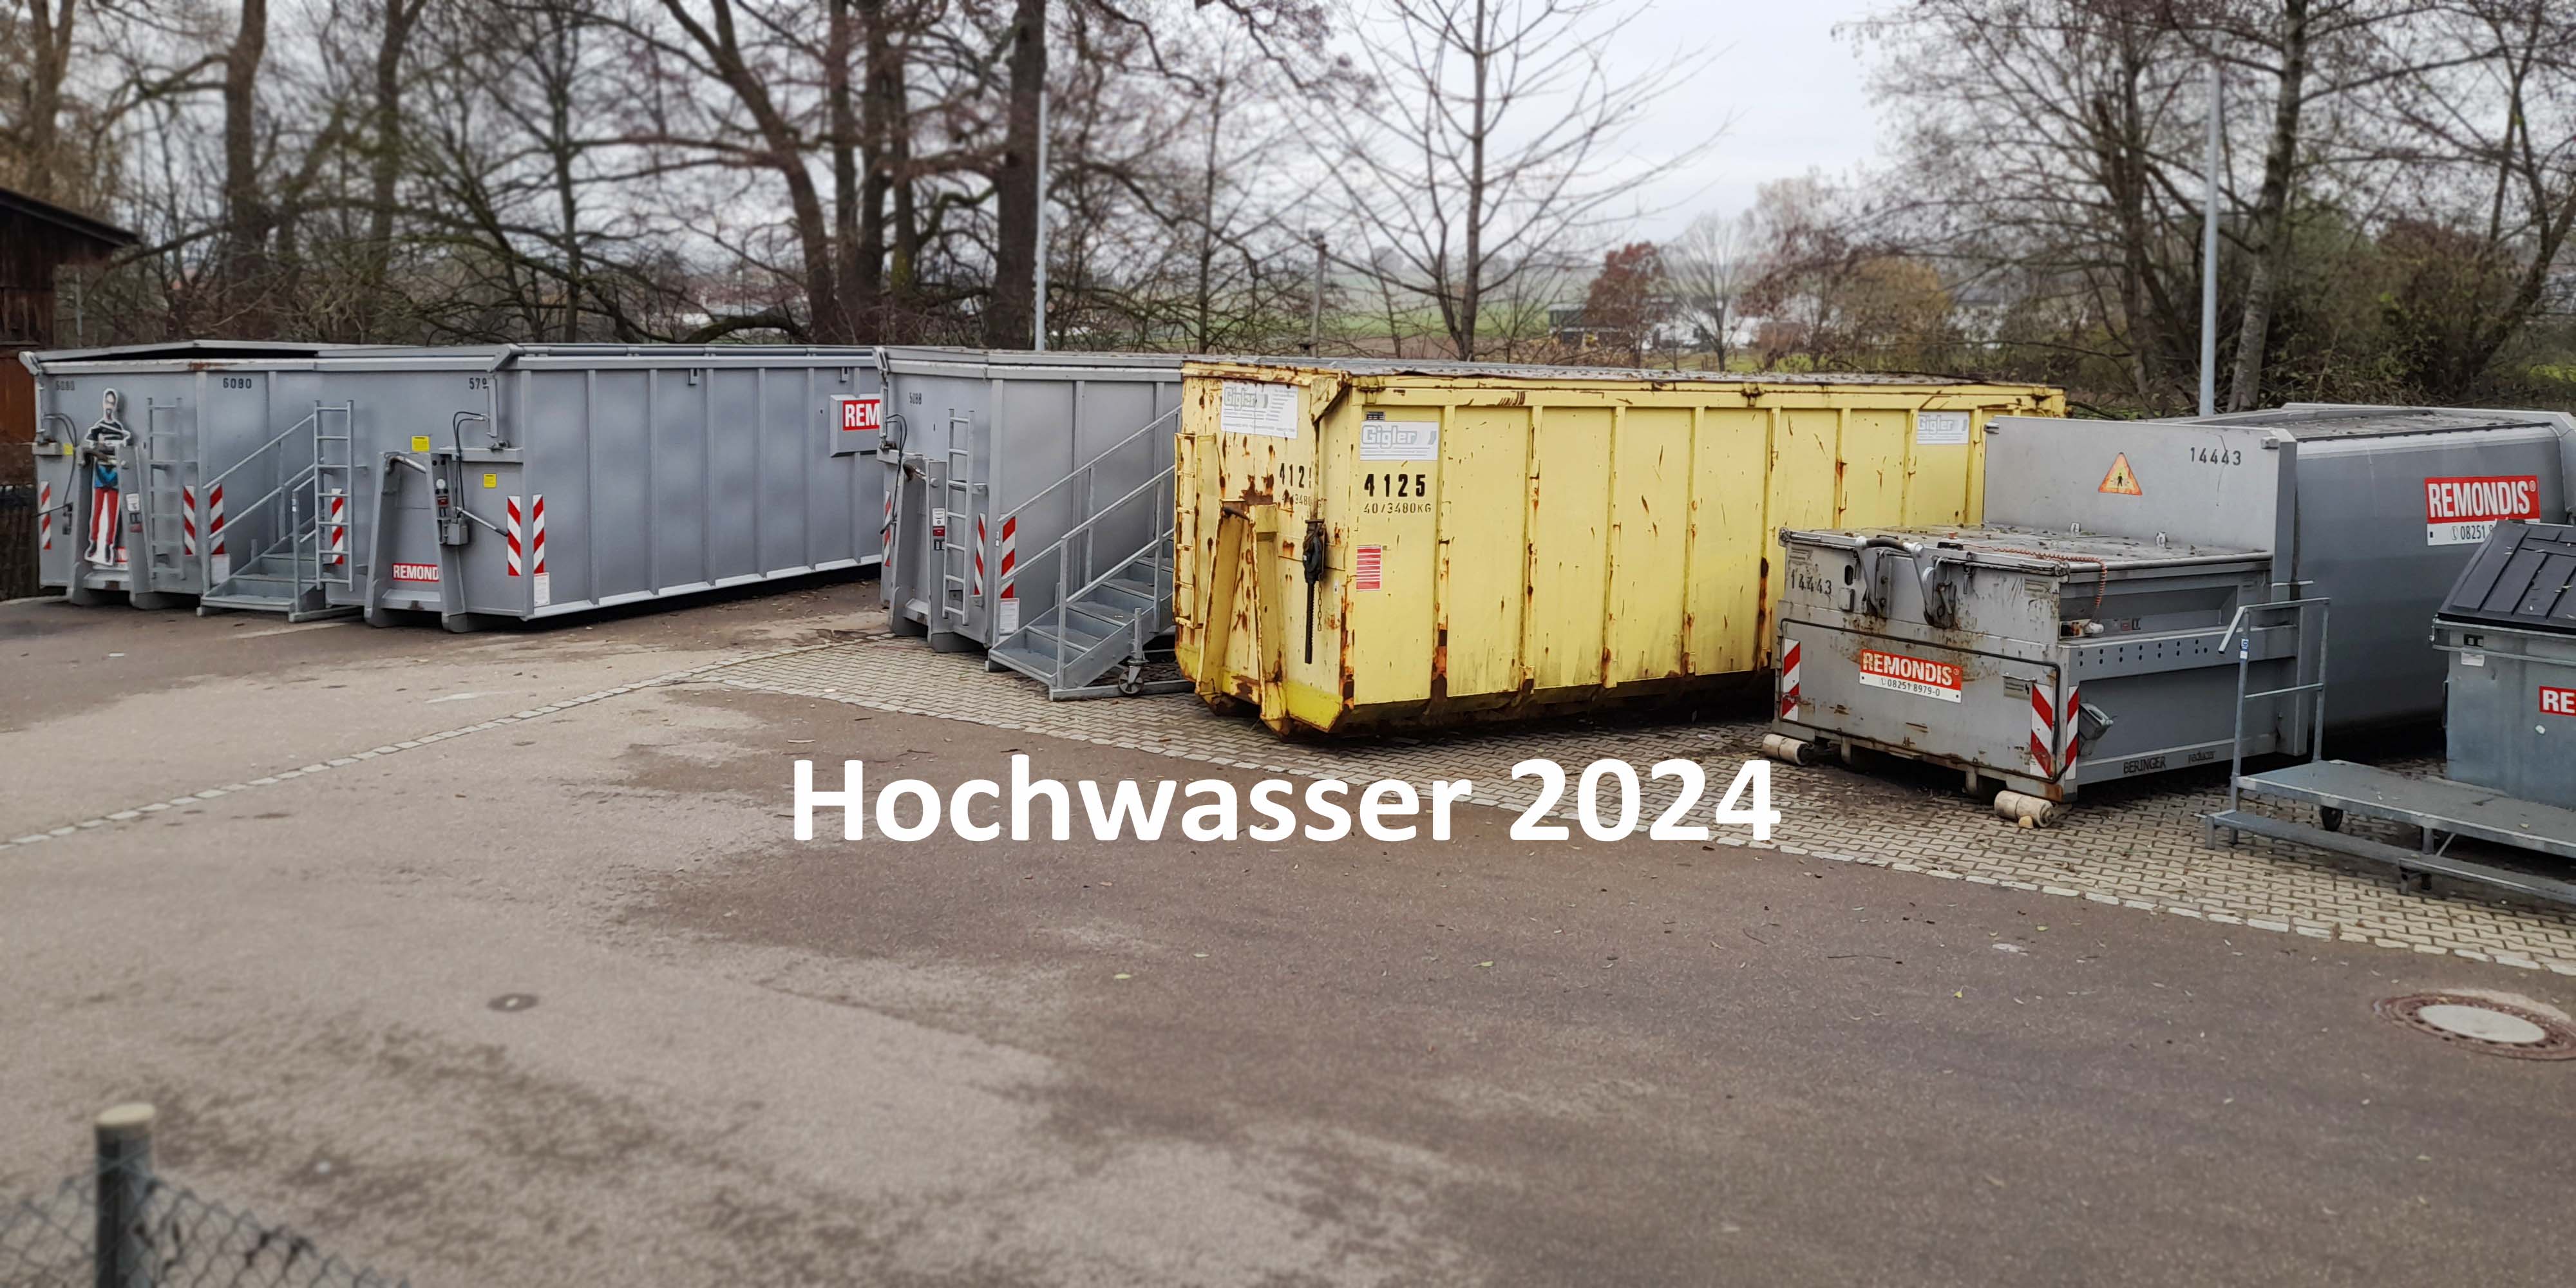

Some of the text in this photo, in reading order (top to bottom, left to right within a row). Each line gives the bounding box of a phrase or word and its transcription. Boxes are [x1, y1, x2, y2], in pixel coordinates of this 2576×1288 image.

[223, 377, 252, 389] 6080
[1224, 386, 1257, 411] Gigler
[845, 402, 880, 427] REM
[1918, 415, 1954, 435] Gigler
[1361, 424, 1417, 449] Gigler
[2190, 446, 2241, 466] 14443
[1363, 473, 1426, 497] 4125
[1363, 502, 1432, 515] 40/3480KG
[2460, 524, 2486, 540] 08251
[1887, 679, 1941, 697] 08251 8979-0
[2543, 689, 2576, 714] RE
[2123, 755, 2167, 774] BERINGER
